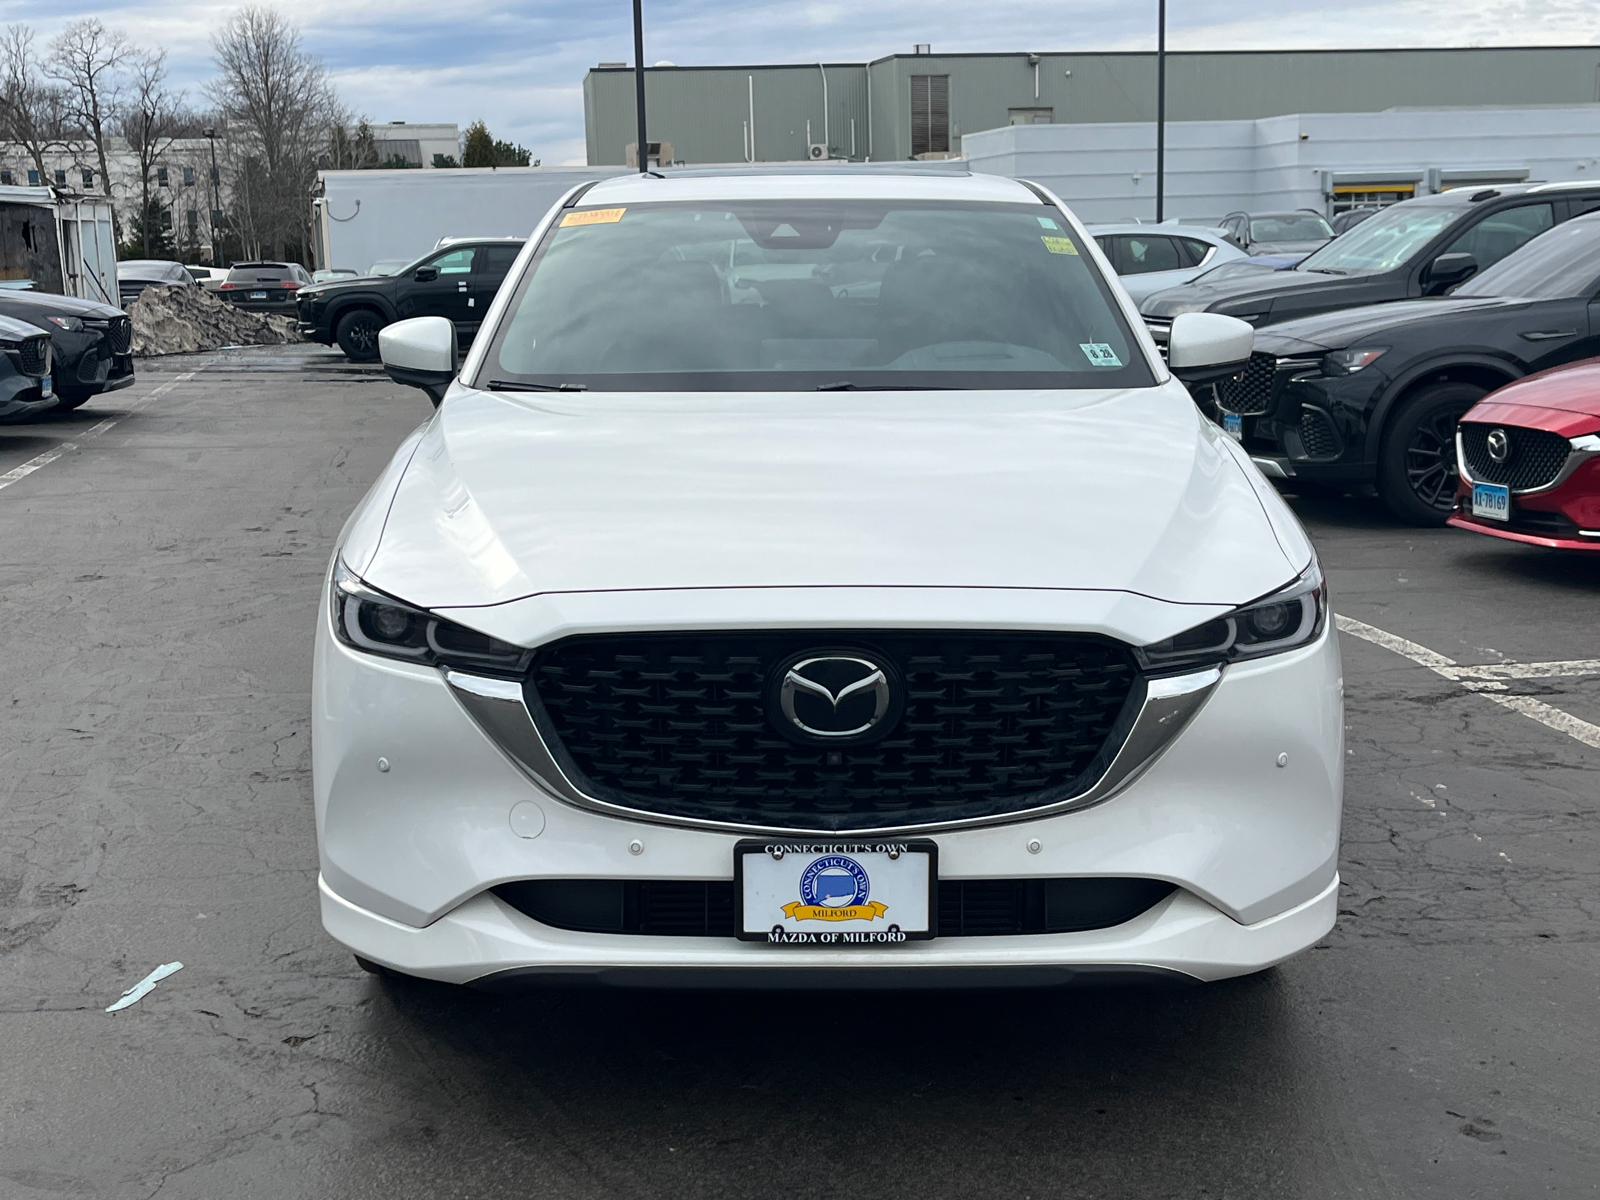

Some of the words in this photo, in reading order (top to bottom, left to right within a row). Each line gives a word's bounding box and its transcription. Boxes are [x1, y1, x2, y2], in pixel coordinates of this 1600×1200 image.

[764, 844, 872, 854] CONNECTICUT'S
[875, 843, 908, 853] OWN
[803, 858, 860, 900] CONNECTICUT'S
[857, 874, 867, 899] OWN
[812, 909, 857, 918] MILFORD
[767, 932, 816, 943] MAZDA
[820, 932, 840, 943] OF
[843, 932, 907, 943] MILFORD
